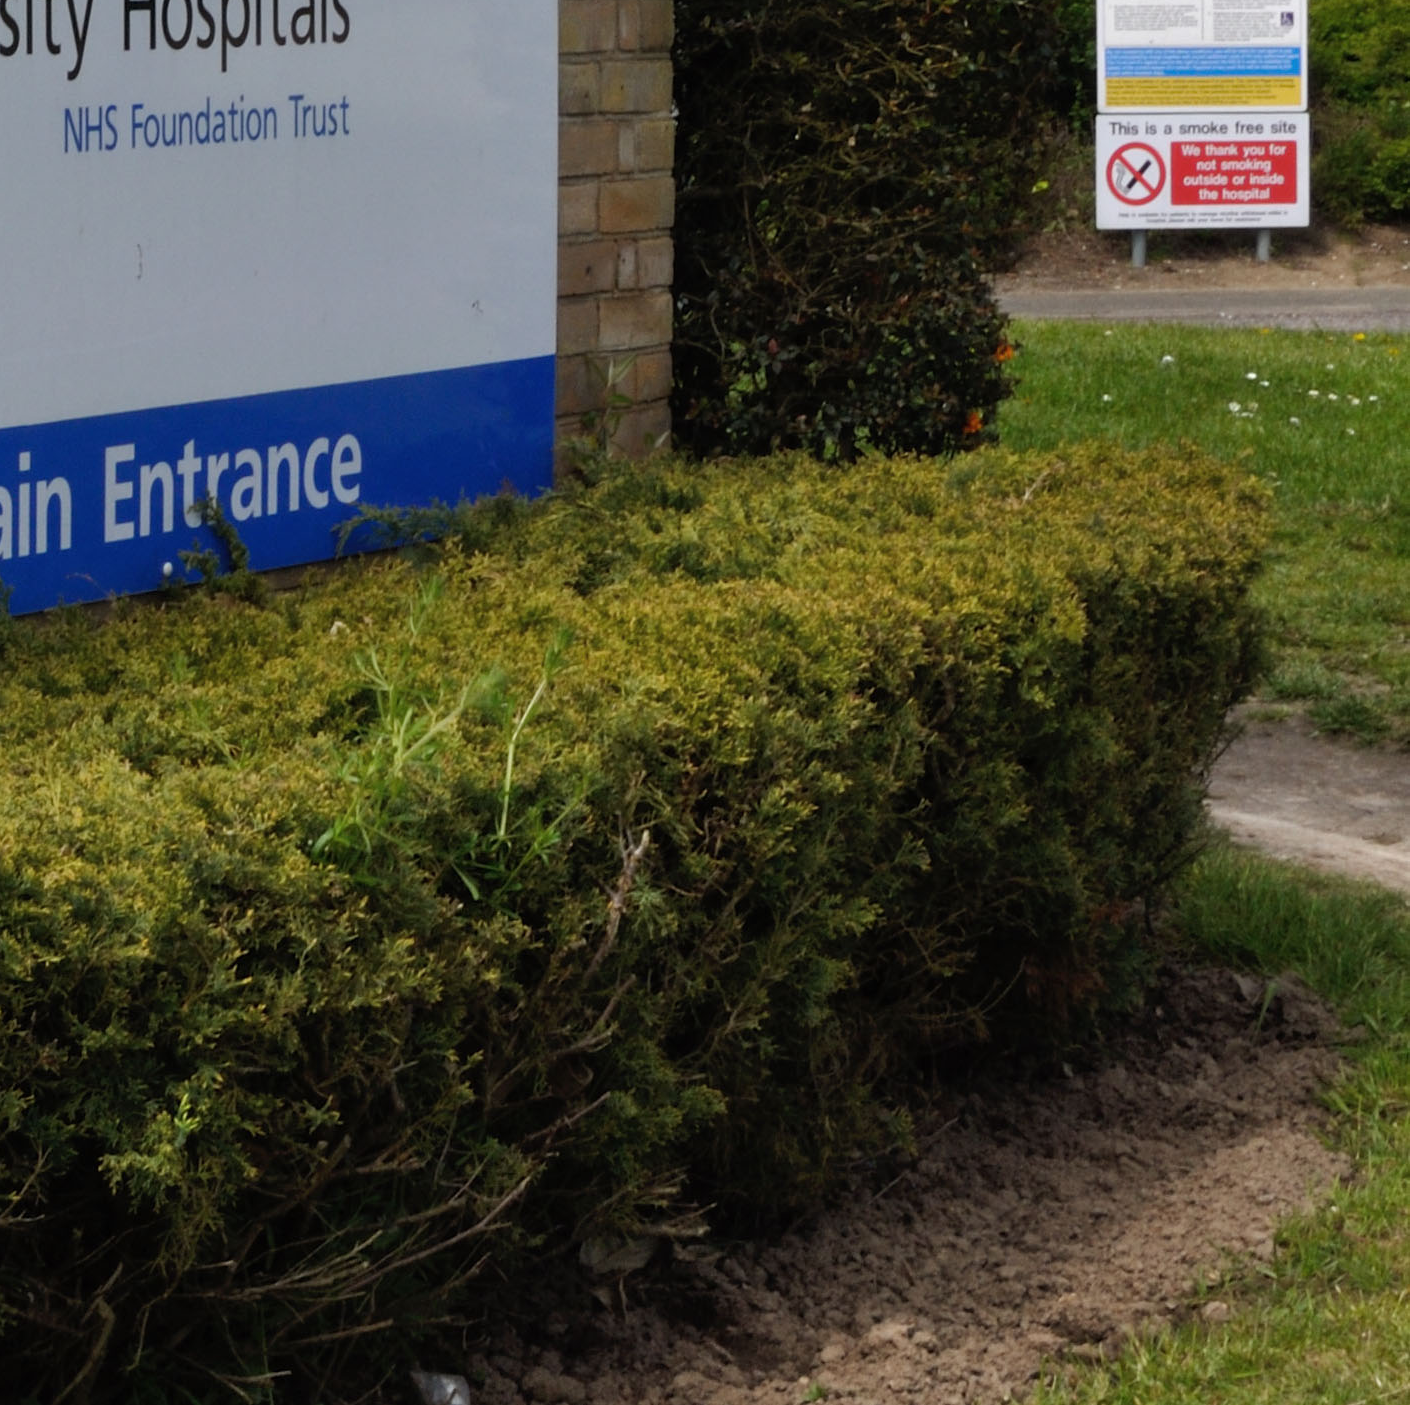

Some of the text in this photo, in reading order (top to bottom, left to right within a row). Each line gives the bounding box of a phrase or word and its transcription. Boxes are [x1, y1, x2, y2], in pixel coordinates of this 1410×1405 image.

[64, 94, 350, 153] NHS Foundation Trust
[1109, 121, 1297, 136] This is a smoke free site
[1181, 144, 1287, 158] We thank you for
[1196, 159, 1272, 172] not smoking
[1183, 173, 1285, 186] outside or inside
[1198, 188, 1271, 202] the hospital
[104, 433, 362, 543] Entrance
